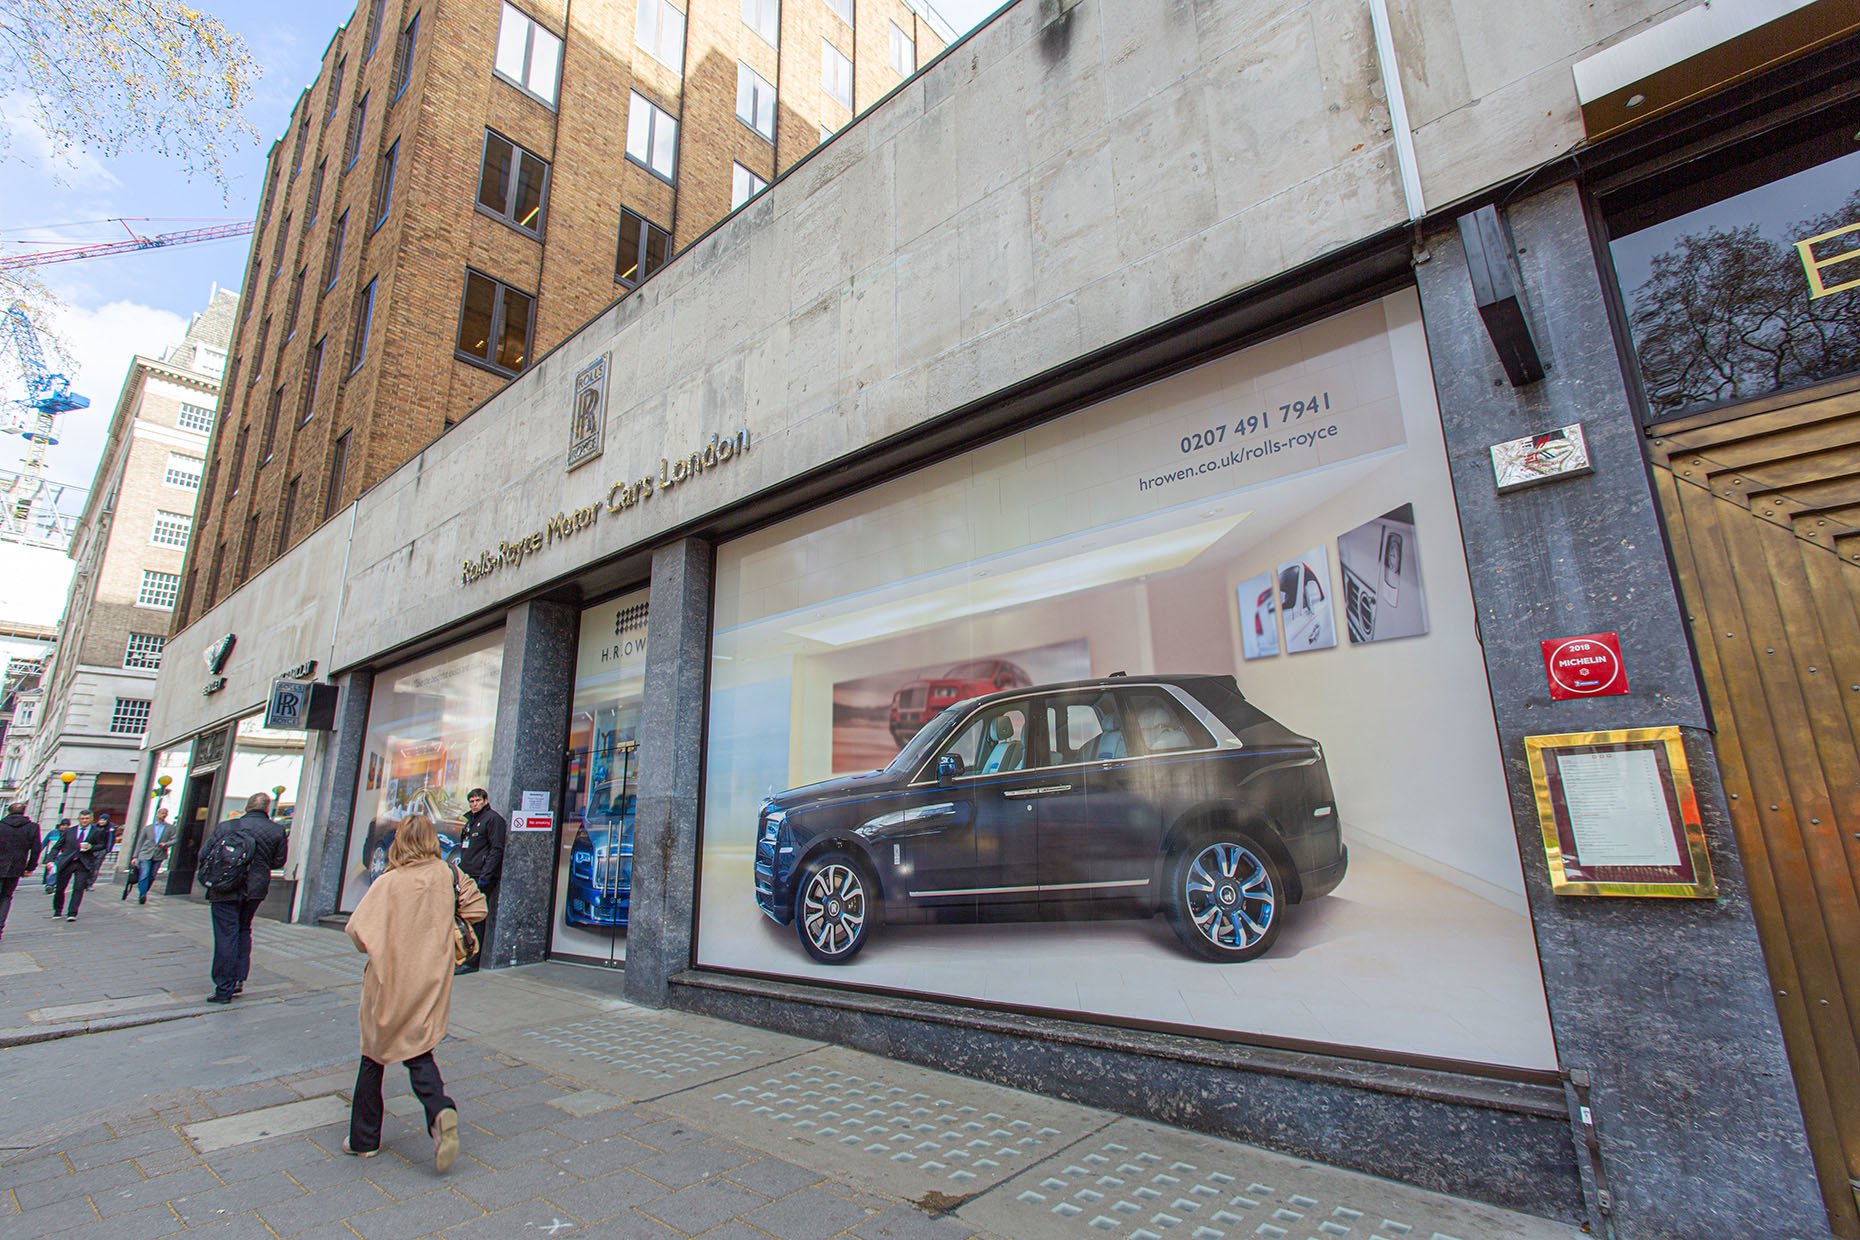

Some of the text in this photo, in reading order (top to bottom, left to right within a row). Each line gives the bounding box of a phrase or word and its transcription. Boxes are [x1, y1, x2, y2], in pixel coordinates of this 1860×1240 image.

[578, 364, 604, 389] ROLLS
[1180, 391, 1330, 453] 0207 491 7941
[1138, 424, 1339, 491] hrowen.co.uk/rolls-royce
[460, 426, 751, 588] Rolls-Royce Motor Cars London
[601, 637, 647, 663] H.R.OW
[1569, 643, 1591, 652] 2018
[1558, 655, 1607, 668] MICHELIN
